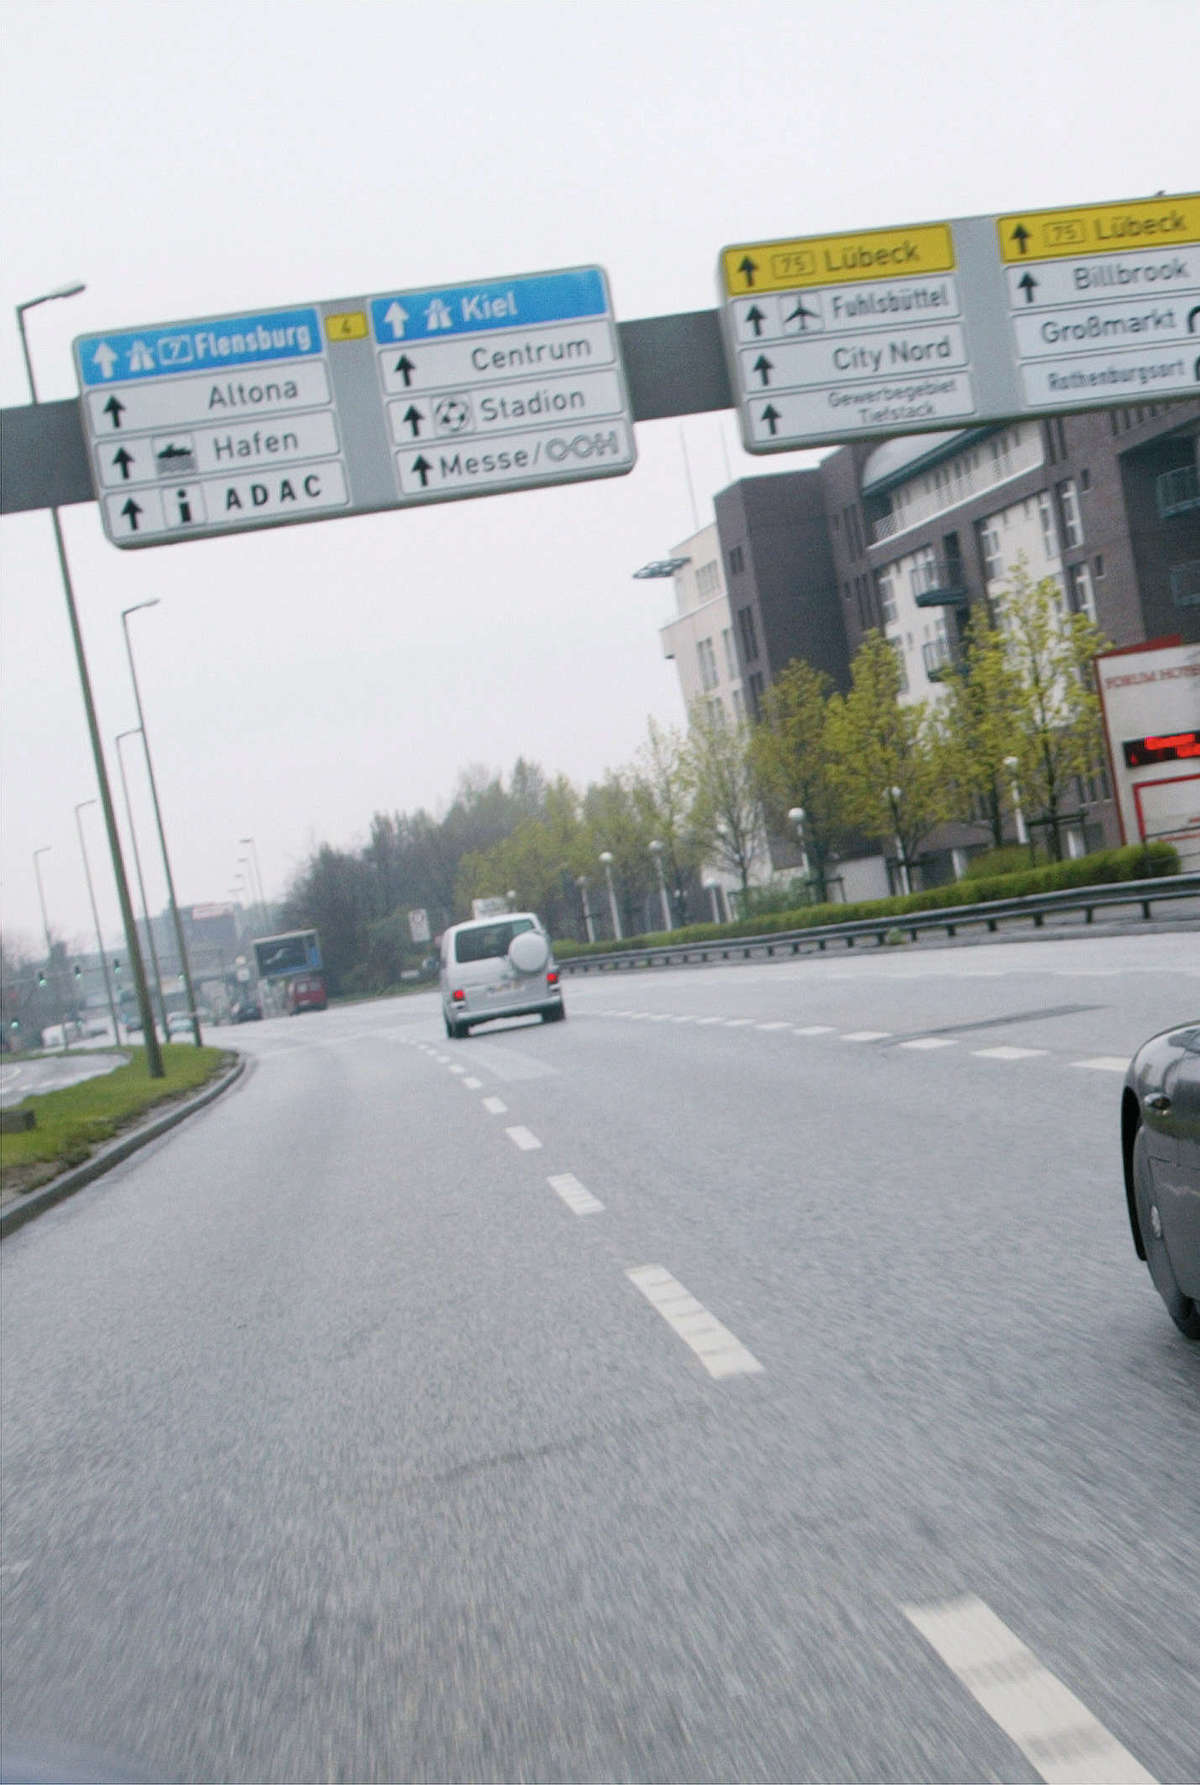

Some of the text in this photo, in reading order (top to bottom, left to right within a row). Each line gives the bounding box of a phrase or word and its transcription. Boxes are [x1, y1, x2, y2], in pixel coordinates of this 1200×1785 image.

[1094, 209, 1187, 240] Lübeck
[782, 240, 920, 273] 75 Lübeck
[1073, 257, 1190, 290] Billbrock
[460, 290, 518, 322] Kiel
[194, 323, 312, 360] Flensburg
[1041, 308, 1178, 344] Großmarkt
[471, 337, 591, 371] Centrum
[832, 335, 951, 373] City Nord
[208, 379, 299, 410] Altona
[480, 389, 585, 421] Stadion
[213, 431, 299, 461] Hafen
[225, 474, 323, 512] ADAC
